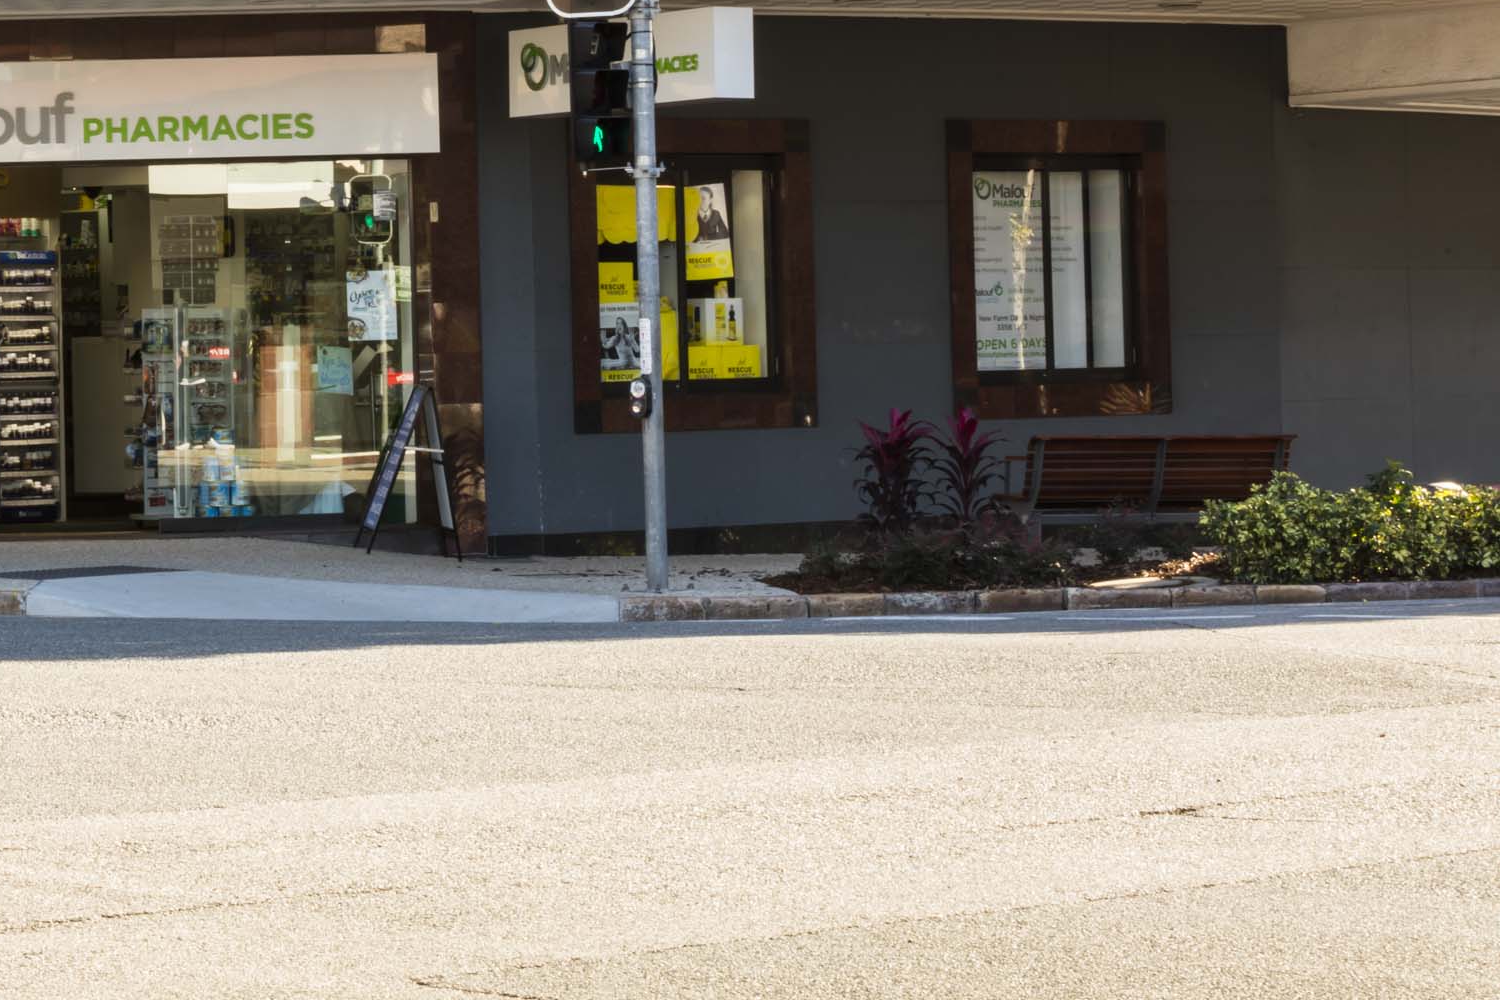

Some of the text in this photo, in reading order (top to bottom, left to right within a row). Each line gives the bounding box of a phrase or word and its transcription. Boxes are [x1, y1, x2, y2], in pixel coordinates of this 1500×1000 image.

[83, 112, 316, 145] PHARMACIES
[688, 256, 713, 265] RESCUE
[600, 283, 626, 291] RESCUE
[976, 338, 1007, 351] OPEN
[1010, 338, 1018, 350] 6
[689, 367, 715, 375] RESCUE
[727, 366, 753, 374] RESCUE
